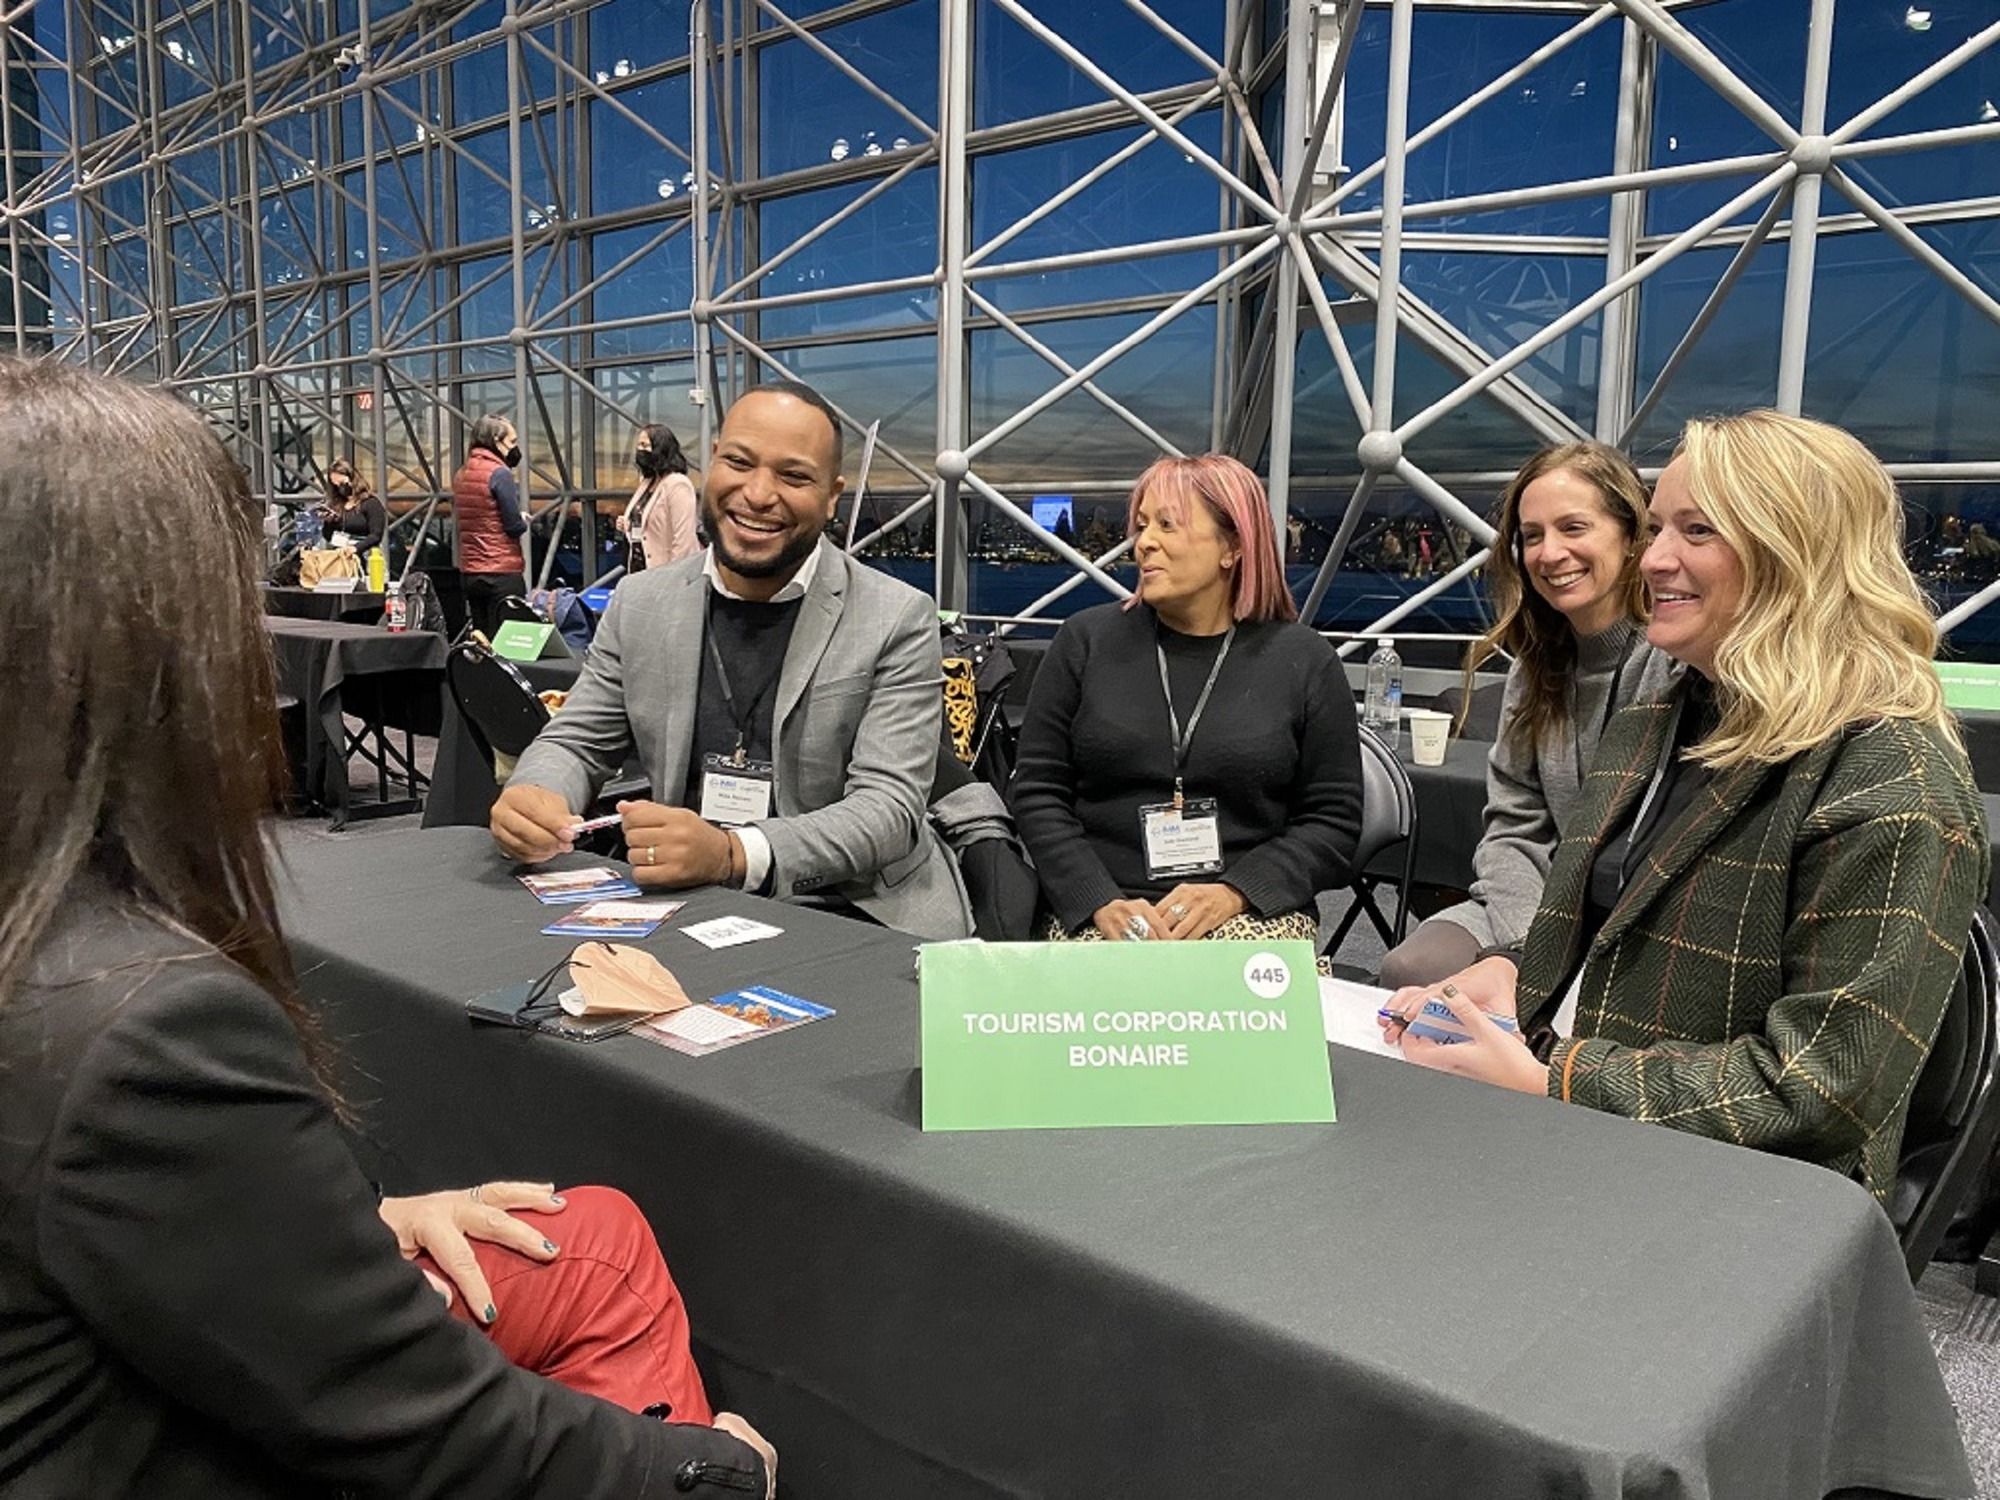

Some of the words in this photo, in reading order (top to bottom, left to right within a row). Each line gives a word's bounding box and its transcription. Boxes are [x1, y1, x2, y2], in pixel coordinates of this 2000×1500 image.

[1249, 968, 1285, 984] 445
[963, 1012, 1085, 1034] TOURISM
[1093, 1010, 1287, 1033] CORPORATION
[1068, 1043, 1189, 1067] BONAIRE
